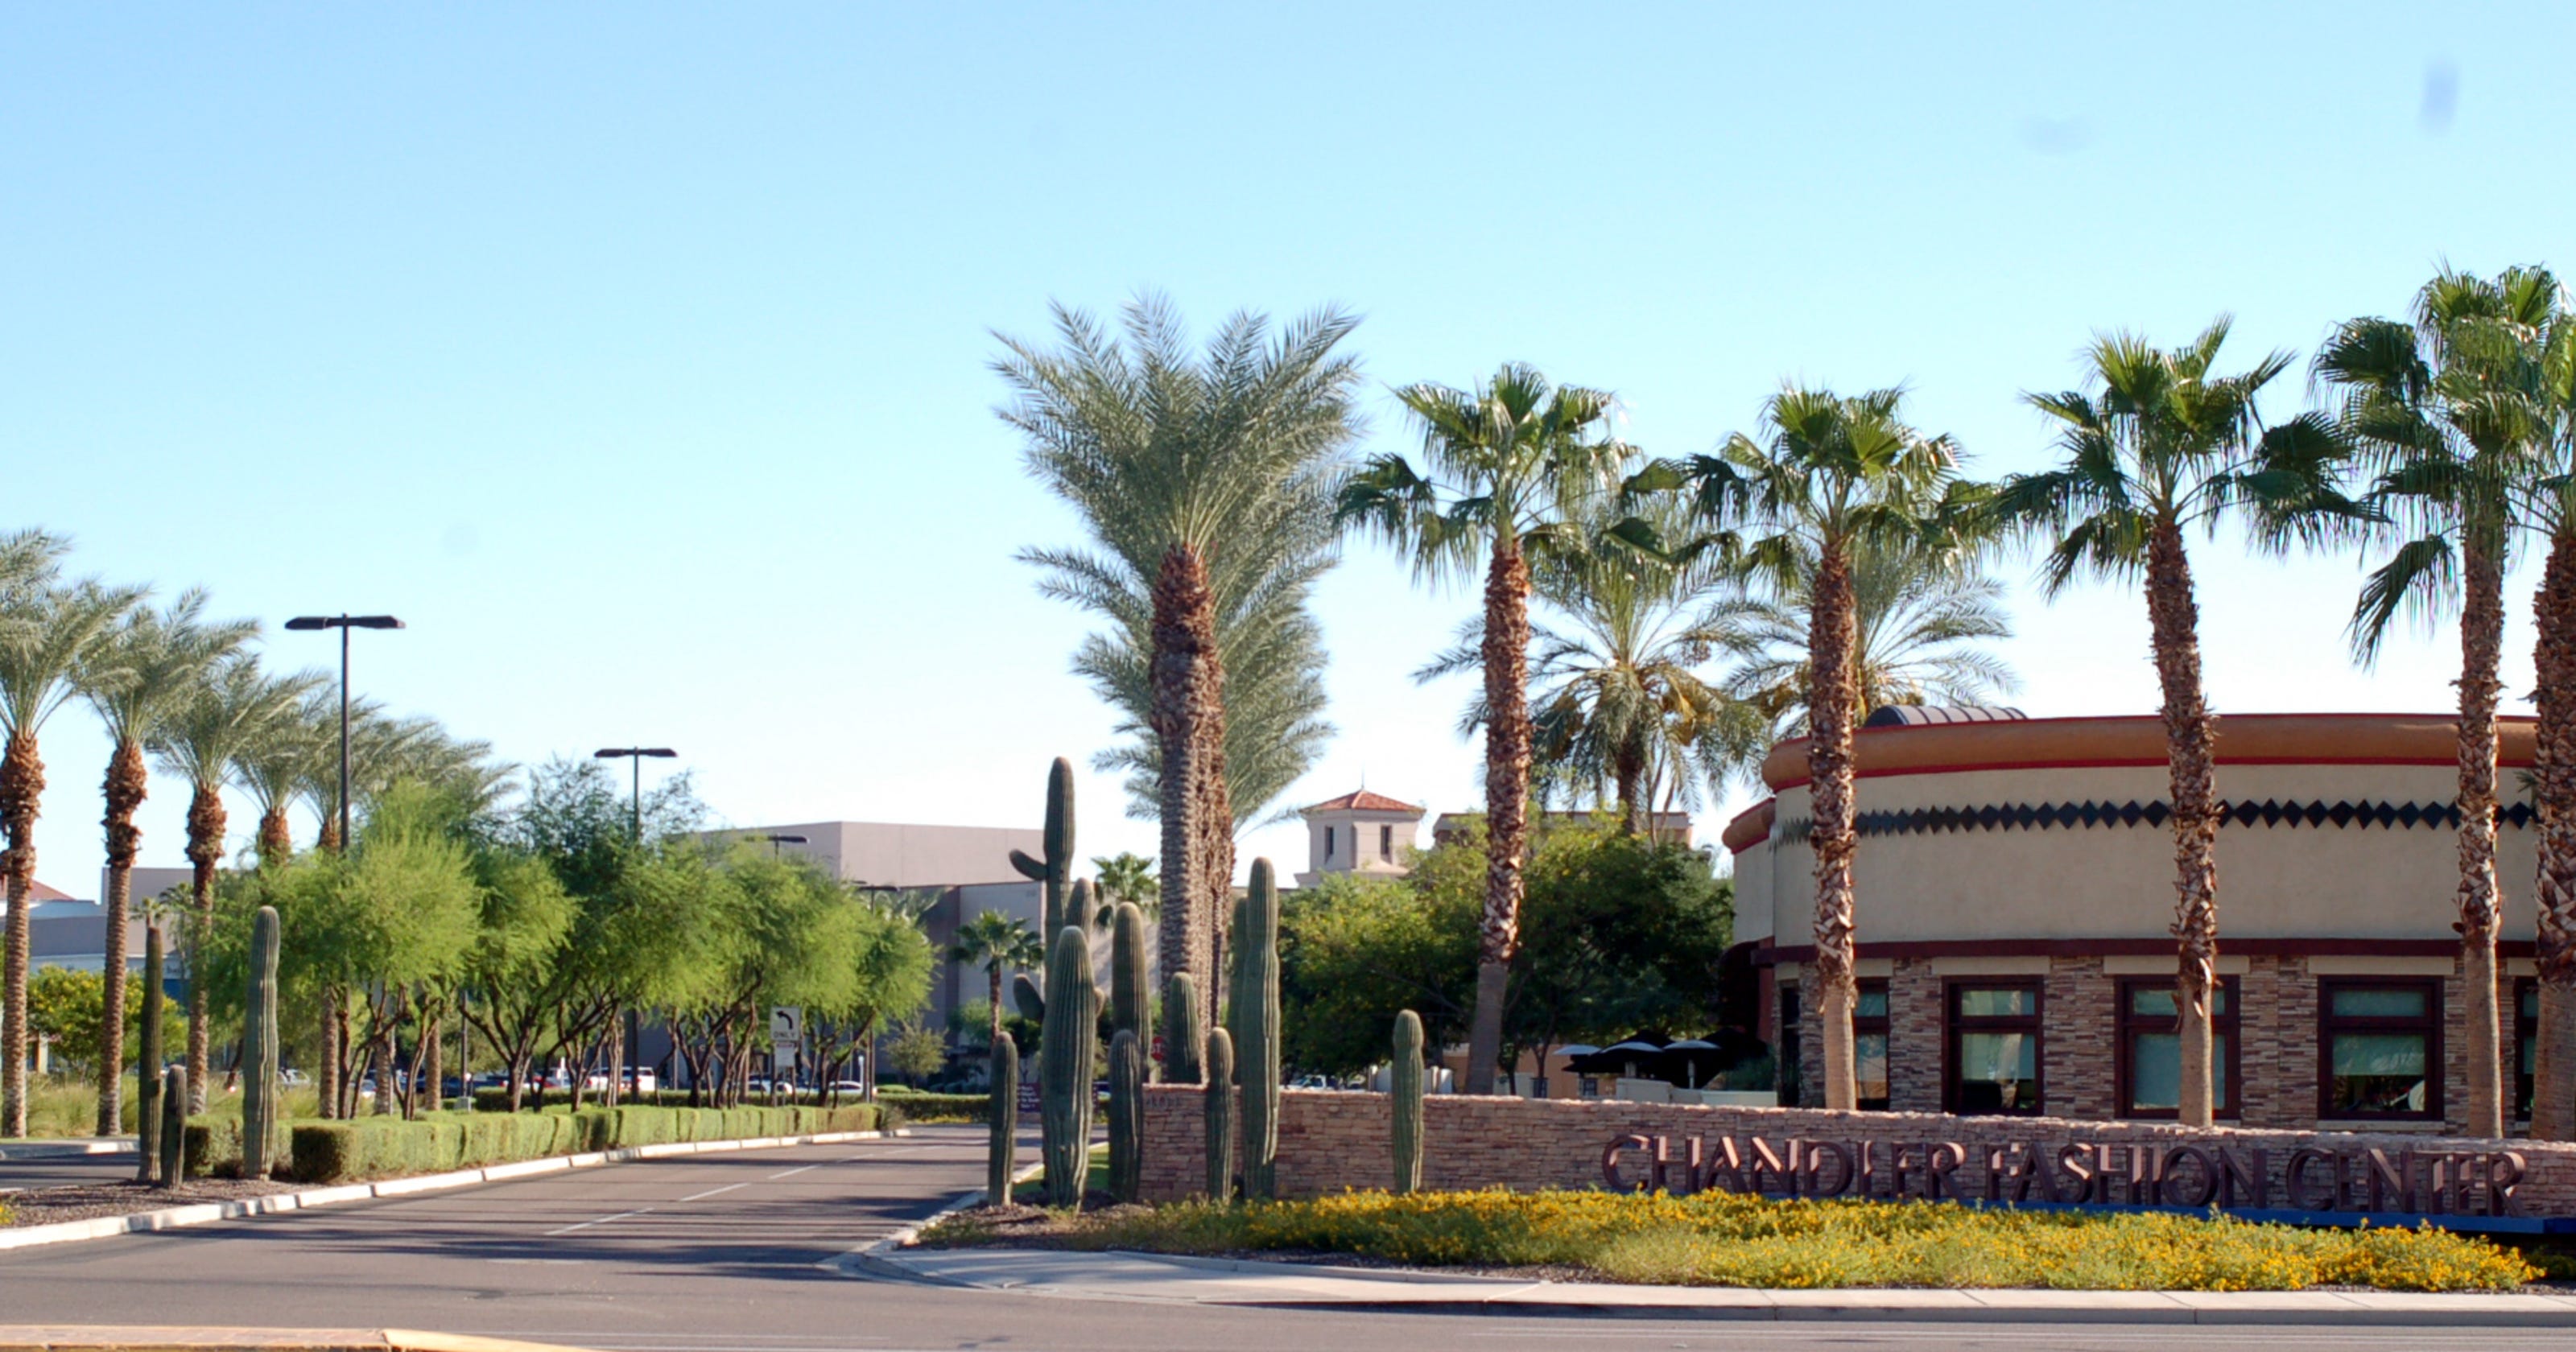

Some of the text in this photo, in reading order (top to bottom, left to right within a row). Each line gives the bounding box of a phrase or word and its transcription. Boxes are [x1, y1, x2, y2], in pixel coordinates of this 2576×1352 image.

[773, 1031, 797, 1039] ONLY
[1602, 1133, 2528, 1218] CHANDLER FASHION CENTER
